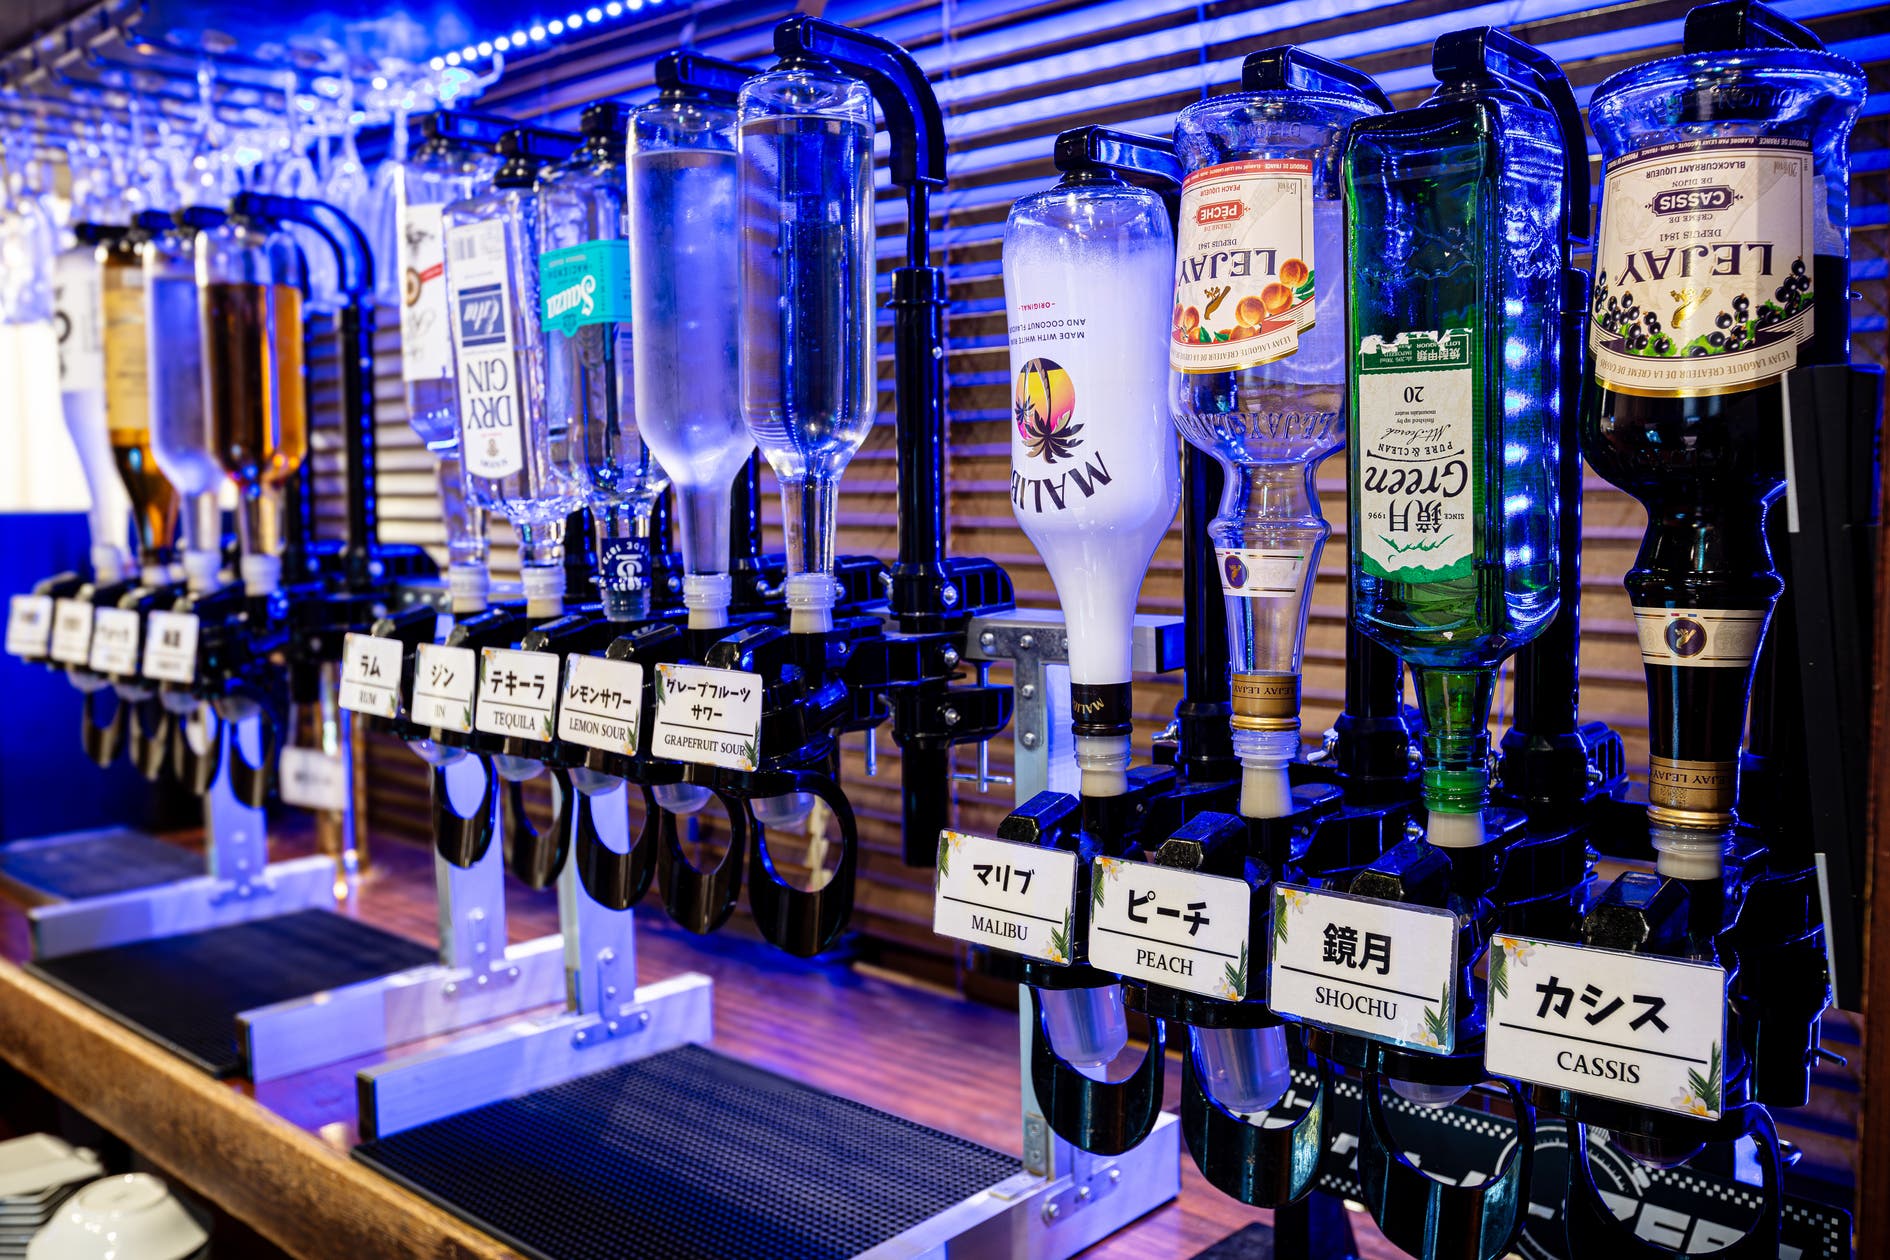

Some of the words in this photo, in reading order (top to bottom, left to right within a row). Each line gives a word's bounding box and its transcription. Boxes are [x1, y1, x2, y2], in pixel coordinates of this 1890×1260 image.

[1701, 138, 1718, 147] LEJAY
[1718, 138, 1730, 146] PAR
[1758, 137, 1781, 146] FRANCE
[1781, 138, 1788, 146] DE
[1645, 166, 1678, 179] LIQUEUR
[1679, 160, 1746, 173] BLACKCURRANT
[1671, 178, 1698, 188] DIJON
[1700, 177, 1713, 185] DE
[1200, 186, 1220, 197] LIQUEUR
[1221, 184, 1241, 193] PEACH
[1659, 190, 1726, 210] CASSIS
[1200, 204, 1237, 220] PÊCHE
[1668, 216, 1682, 224] DE
[1659, 232, 1680, 242] 1841
[1682, 229, 1722, 239] DEPUIS
[1198, 241, 1211, 250] 1841
[1212, 239, 1238, 249] DEPUIS
[1178, 249, 1277, 287] LEJAY
[1617, 243, 1775, 287] LEJAY
[1027, 319, 1065, 331] COCONUT
[1066, 318, 1086, 328] AND
[1018, 335, 1036, 345] WHITE
[1037, 333, 1057, 342] WITH
[1059, 331, 1085, 340] MADE
[1271, 336, 1291, 349] LEJAY
[1240, 343, 1271, 357] LAGOUTE
[1767, 350, 1791, 365] LEJAY
[1616, 366, 1626, 376] DE
[1727, 357, 1767, 373] LAGOUTE
[466, 358, 509, 395] GIN
[1653, 370, 1664, 379] LA
[1665, 370, 1678, 379] DE
[1679, 366, 1725, 379] CREATEUR
[1403, 386, 1425, 403] 20
[466, 394, 513, 430] DRY
[1396, 417, 1404, 425] by
[1403, 417, 1411, 425] up
[1411, 417, 1435, 425] finished
[1377, 443, 1410, 456] CLEAN
[1411, 447, 1420, 458] &
[1424, 441, 1453, 455] PURE
[1010, 451, 1113, 514] MALIB
[1363, 460, 1469, 498] Green
[1367, 511, 1387, 520] 1996
[1388, 499, 1443, 534] 鏡月
[1443, 512, 1465, 520] SINCE
[360, 655, 381, 678] ラム
[431, 664, 455, 688] ジン
[491, 670, 545, 700] テキーラ
[666, 678, 751, 702] グレープフルーツ
[1233, 685, 1260, 695] LEJAY
[569, 685, 632, 710] レモンサワー
[691, 703, 723, 721] サワー
[1071, 697, 1105, 715] MALI
[494, 711, 536, 730] TEQUILA
[569, 717, 600, 735] LEMON
[601, 724, 626, 741] SOUR
[664, 734, 719, 752] GRAPEFRUIT
[720, 742, 746, 756] SOUR
[1653, 769, 1688, 783] LEJAY
[973, 864, 1035, 895] マリブ
[1128, 889, 1210, 937] ピーチ
[971, 914, 1028, 941] MALIBU
[1322, 922, 1392, 975] 鏡月
[1135, 948, 1194, 977] PEACH
[1315, 986, 1398, 1021] SHOCHU
[1535, 975, 1671, 1033] カシス
[1557, 1050, 1641, 1084] CASSIS
